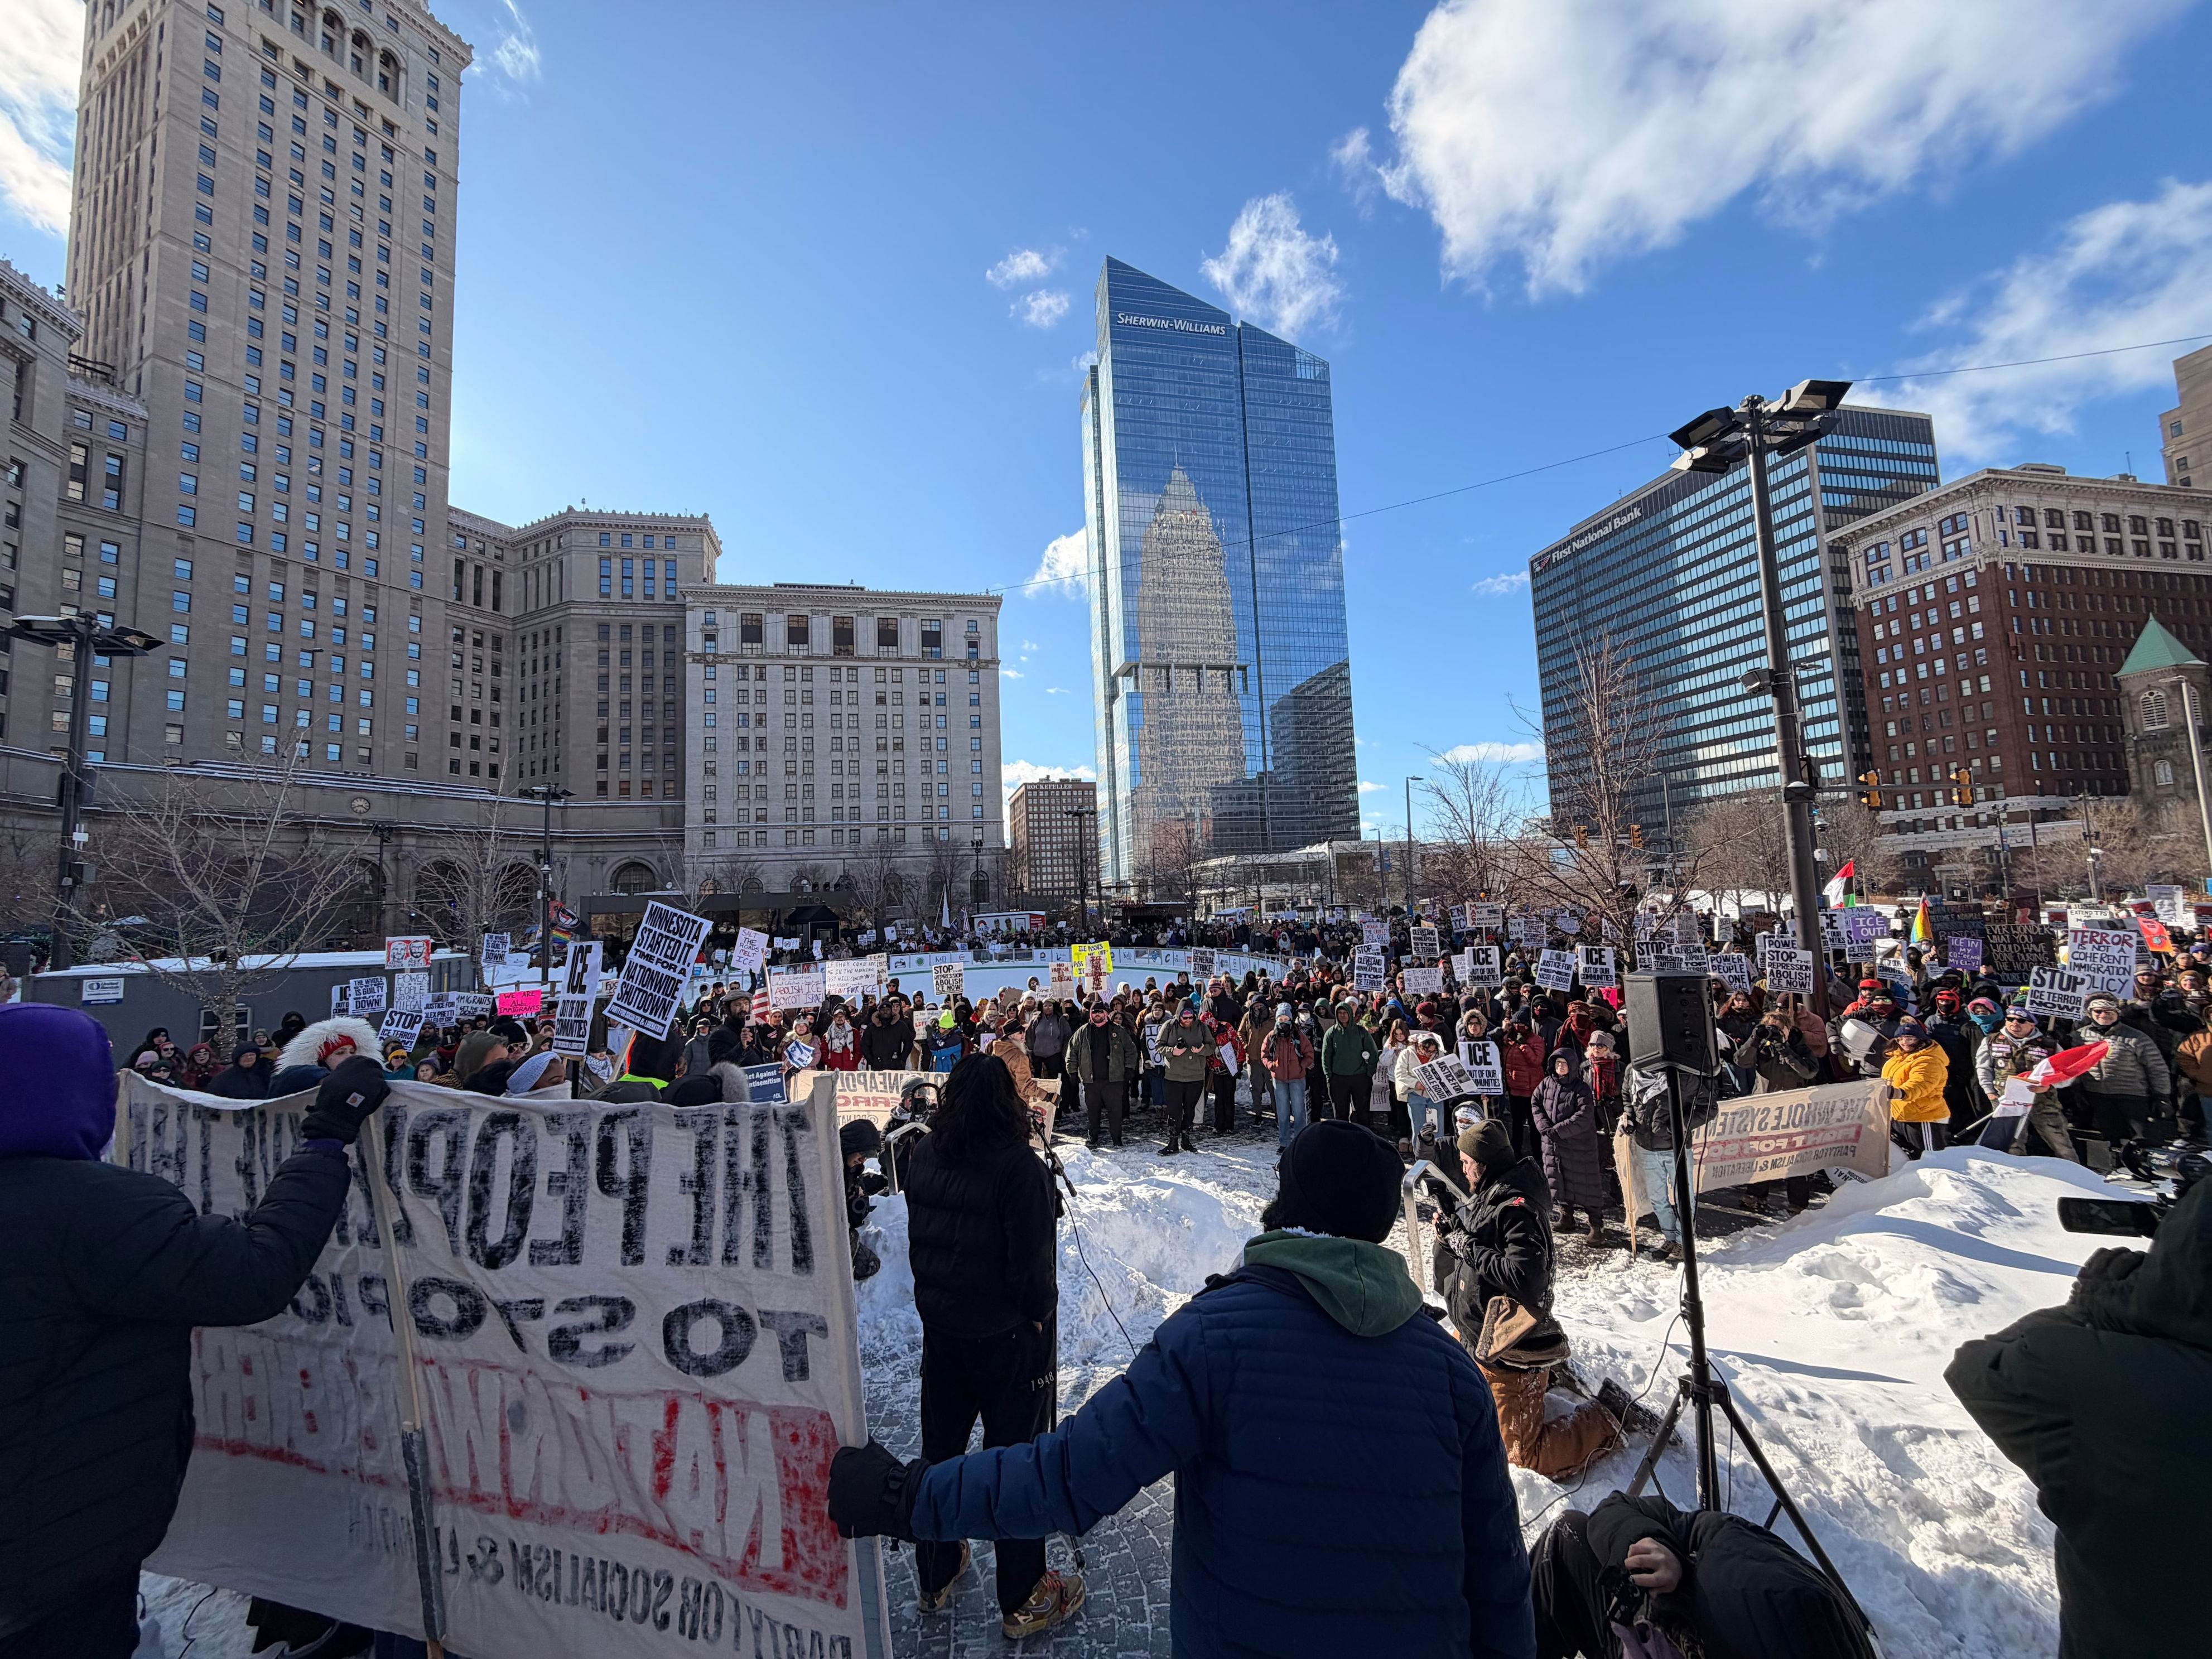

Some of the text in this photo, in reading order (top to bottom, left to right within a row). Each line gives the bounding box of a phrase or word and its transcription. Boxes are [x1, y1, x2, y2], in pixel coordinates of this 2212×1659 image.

[1117, 312, 1226, 335] SHERWIN-WILLIAMS
[1551, 507, 1642, 563] First National Bank
[645, 904, 704, 943] MINNESOTA
[1855, 917, 1885, 927] ICE
[741, 929, 759, 938] SALT
[1861, 926, 1887, 937] OUT!
[1986, 924, 2052, 935] EVER WONDER
[744, 937, 757, 946] THE
[1768, 939, 1797, 949] POWE
[1951, 938, 1964, 947] ICE
[1987, 934, 2033, 944] WHAT YOU
[2070, 929, 2134, 948] TERROR
[637, 926, 681, 964] STARTED
[739, 942, 759, 952] ROADS
[1357, 945, 1372, 954] STOP
[1636, 942, 1666, 956] STOP
[1989, 943, 2046, 953] WOULD HAVE
[485, 952, 505, 961] DOWN!
[739, 948, 757, 957] MELT
[1193, 948, 1208, 957] EXPAND
[1472, 947, 1493, 965] ICE
[1585, 947, 1606, 966] ICE
[1767, 949, 1797, 962] STOP
[1992, 952, 2049, 963] DONE DURING
[2071, 951, 2130, 965] COHERENT
[634, 948, 687, 977] TIME FOR A
[736, 956, 755, 966] ICE
[1193, 956, 1215, 964] GENERAL
[1357, 957, 1382, 966] CLEVELAND
[1541, 959, 1573, 971] JUSTICE FOR
[1710, 955, 1743, 964] POWER
[567, 945, 593, 995] ICE
[933, 964, 953, 974] STOP
[1193, 963, 1213, 972] STRIKE!
[1356, 965, 1382, 973] MINNEAPOLIS
[1712, 964, 1745, 973] PEOPLE
[1767, 962, 1811, 972] REPRESSION
[1994, 961, 2009, 971] THE
[2069, 962, 2132, 976] IMMIGRATION
[1539, 967, 1571, 977] RENEE
[1768, 969, 1811, 982] ABOLISH
[397, 973, 428, 983] POWER
[623, 960, 683, 1000] NATIONWIDE
[935, 978, 963, 986] ABOLISH
[1363, 978, 1382, 987] TERROR
[1538, 972, 1569, 984] NICOLE GOOD
[1729, 975, 1746, 983] ONE
[1770, 977, 1810, 989] ICE NOW!
[2032, 967, 2086, 993] STOP
[363, 986, 384, 995] GUILTY
[396, 986, 425, 995] PEOPLE
[774, 985, 803, 995] ABOLISH
[804, 983, 822, 993] ICE
[860, 984, 877, 993] ICE
[616, 981, 674, 1021] SHUTDOWN!
[774, 994, 801, 1006] BOYCOTT
[2030, 989, 2083, 1006] ICE TERROR
[355, 999, 383, 1009] DOWN!
[395, 1000, 422, 1010] ILLEGAL
[499, 1005, 541, 1014] IMMIGRANTS
[560, 1000, 587, 1019] OUT OUR
[2029, 999, 2081, 1014] NOW!
[385, 1010, 423, 1030] STOP
[556, 1018, 587, 1038] COMMUNITIES
[380, 1028, 417, 1040] ICE TERROR
[1467, 1043, 1492, 1066] ICE
[755, 1069, 777, 1079] Against
[1436, 1061, 1464, 1093] JUSTICE FOR
[748, 1077, 781, 1088] ntisemitism
[1420, 1066, 1447, 1099] NICOLE GOOD
[1428, 1064, 1453, 1097] RENEE
[1030, 1371, 1054, 1391] 1948
